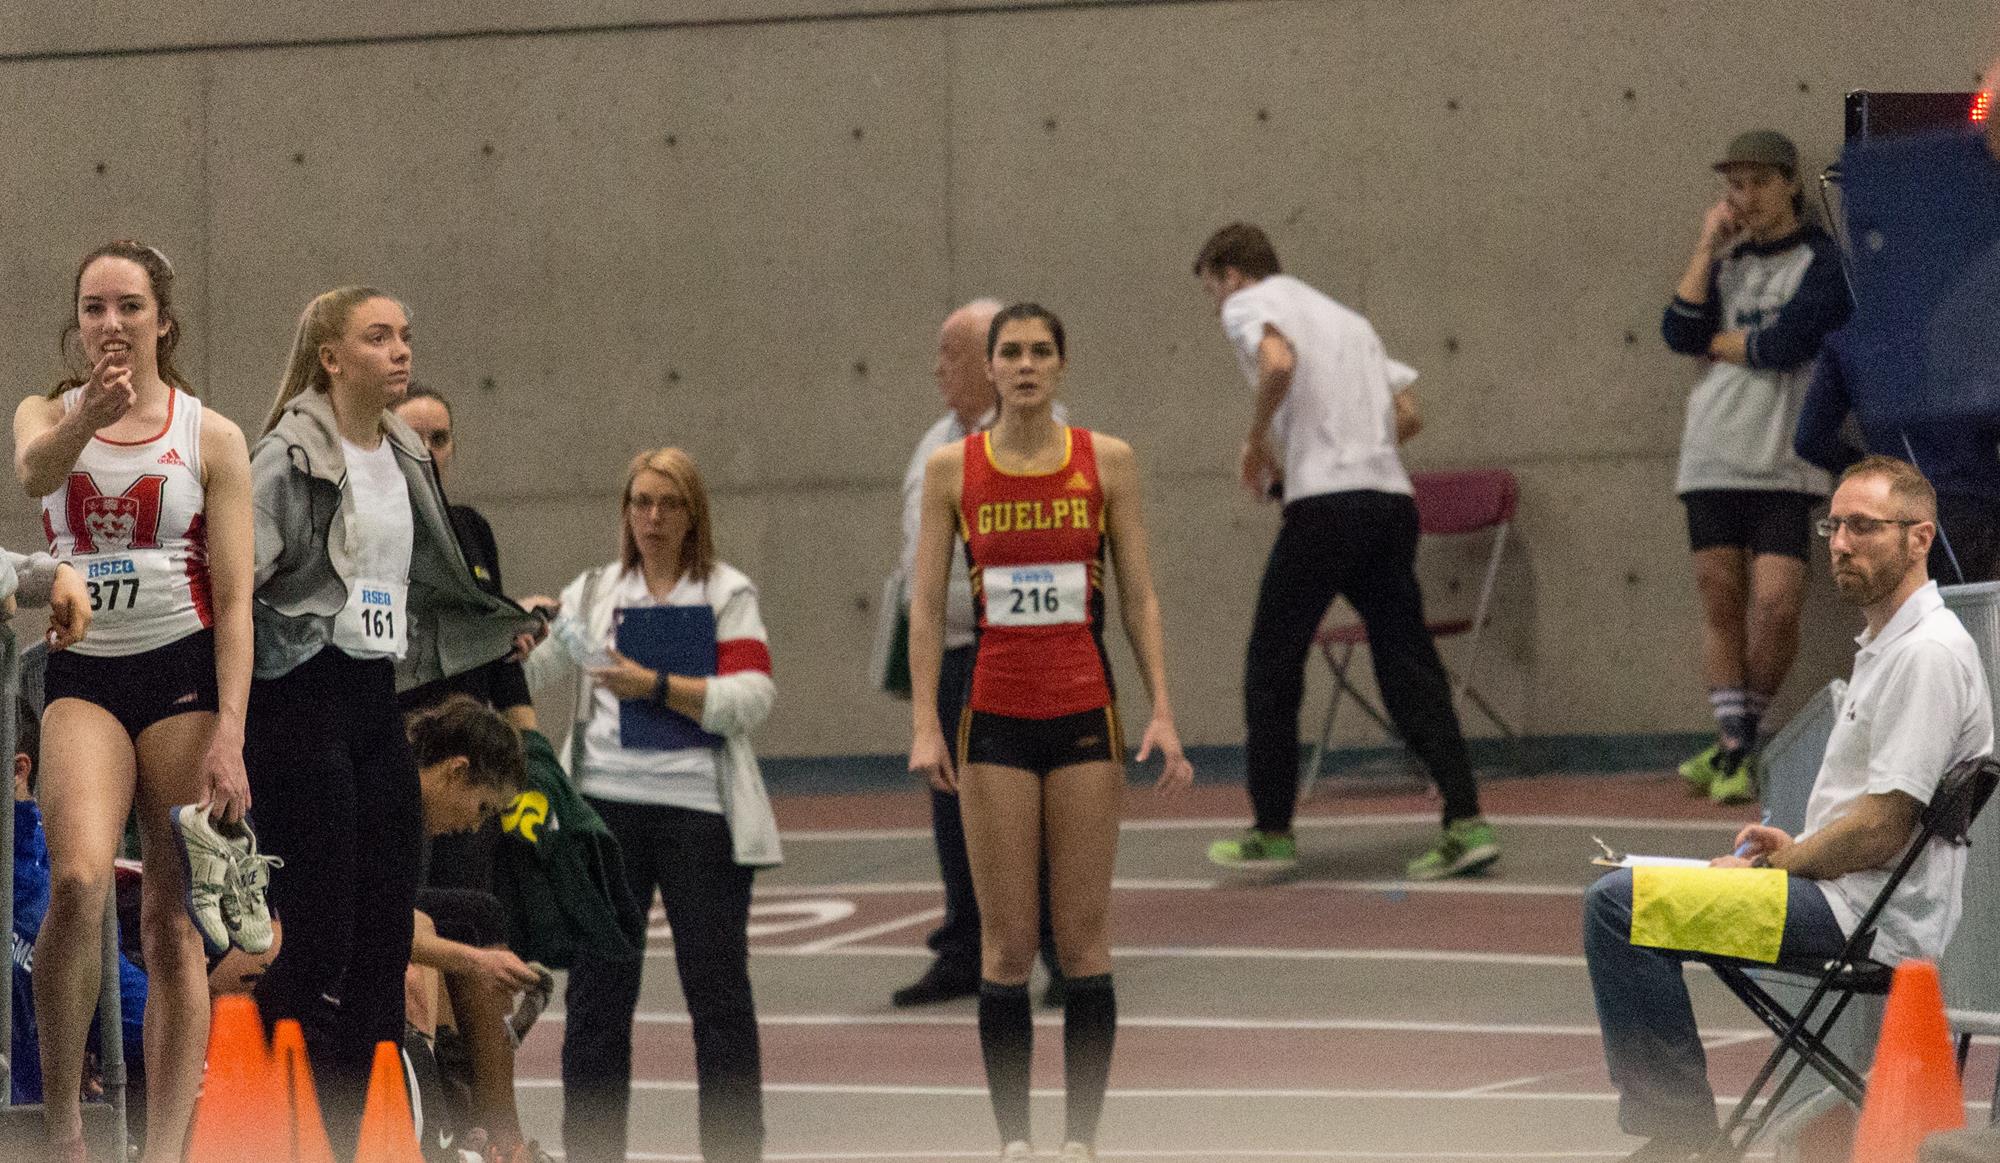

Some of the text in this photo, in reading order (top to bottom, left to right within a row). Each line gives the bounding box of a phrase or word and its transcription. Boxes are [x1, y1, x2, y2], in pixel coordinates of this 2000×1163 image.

[978, 499, 1091, 535] GUELPH
[362, 589, 392, 607] RSEQ
[1009, 587, 1059, 613] 216
[361, 609, 394, 639] 161
